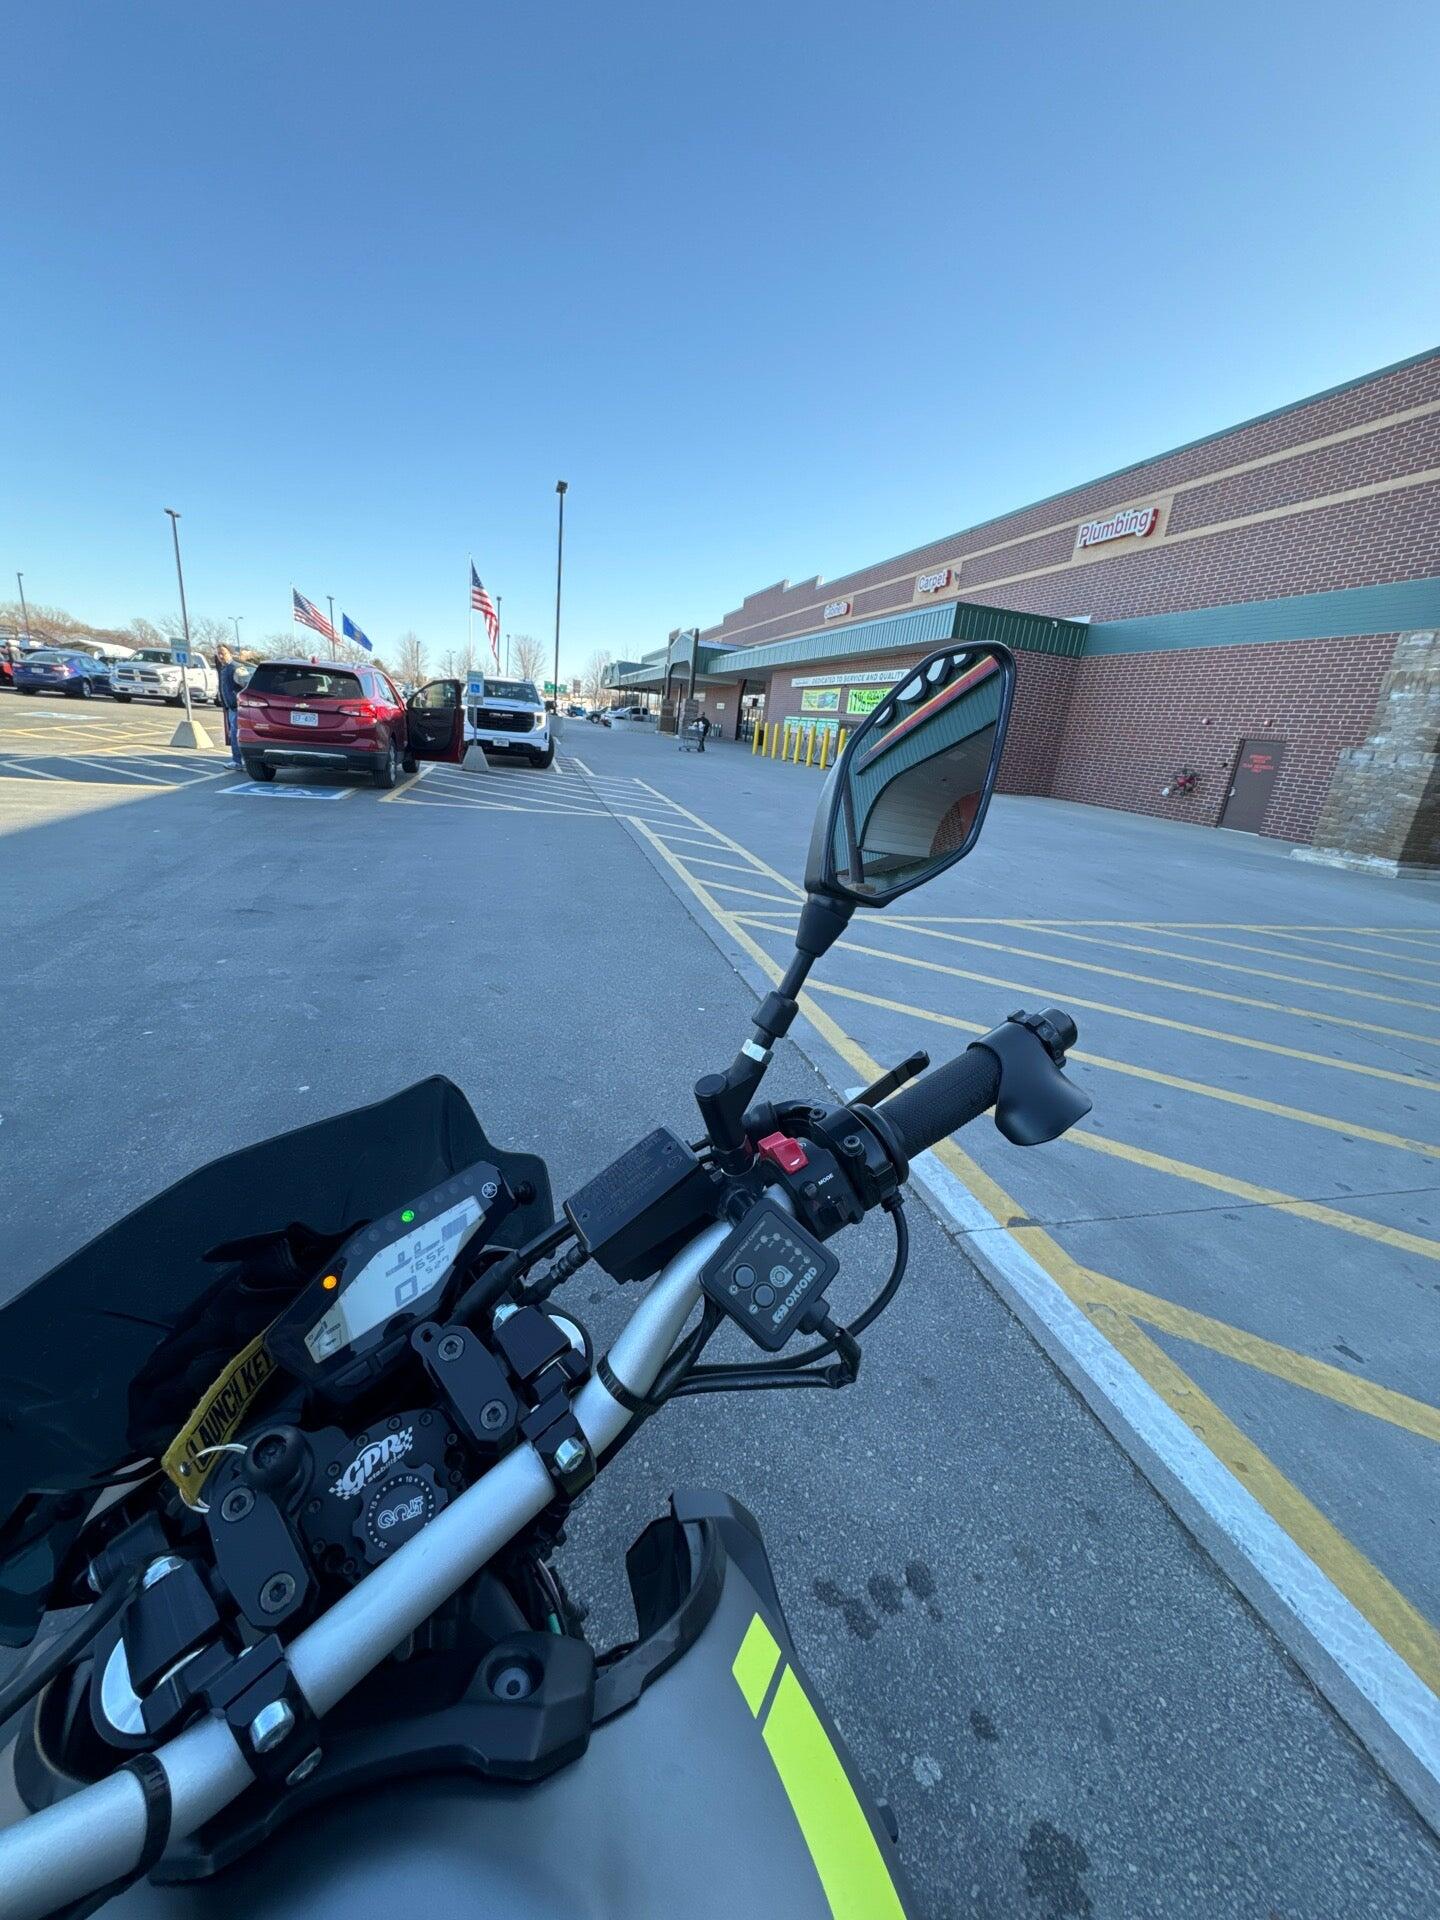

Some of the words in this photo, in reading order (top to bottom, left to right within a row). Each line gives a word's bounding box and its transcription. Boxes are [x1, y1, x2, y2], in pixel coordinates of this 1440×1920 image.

[1078, 508, 1154, 546] Plumbing
[918, 569, 950, 592] Carpet
[812, 676, 836, 685] DEDICATED
[844, 674, 864, 683] SERVICE
[865, 672, 878, 681] AND
[879, 671, 905, 681] QUALITY
[818, 1172, 834, 1185] MODE
[785, 1267, 817, 1307] OXFORD
[189, 1376, 246, 1467] LAUNCH
[341, 1434, 405, 1491] GPR
